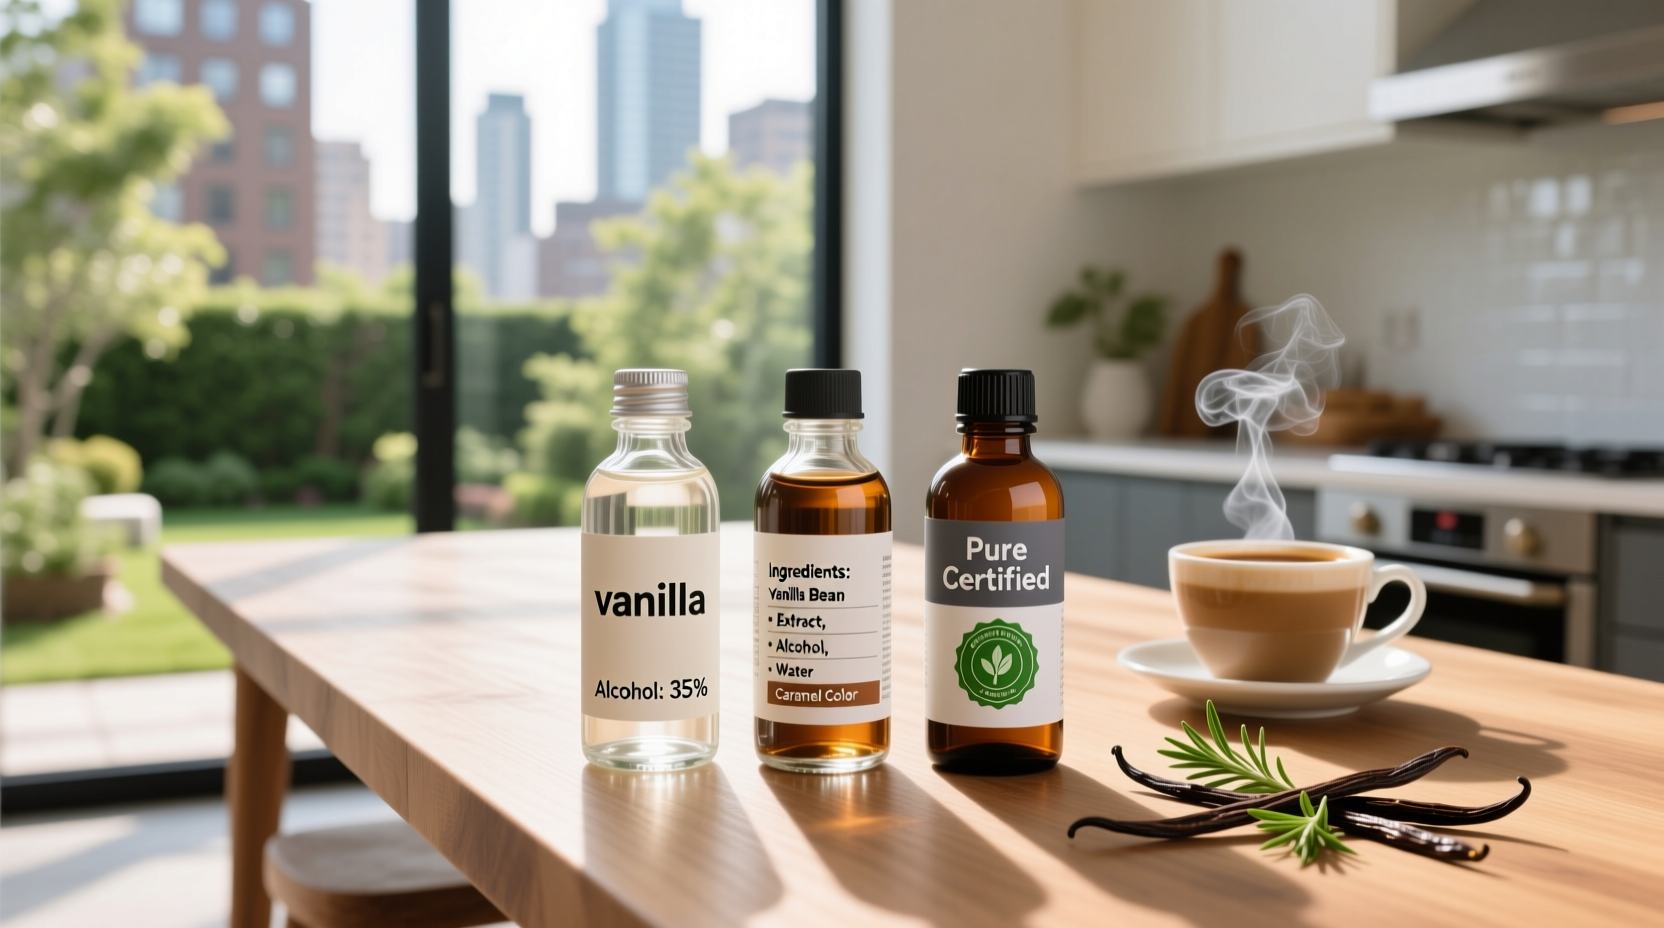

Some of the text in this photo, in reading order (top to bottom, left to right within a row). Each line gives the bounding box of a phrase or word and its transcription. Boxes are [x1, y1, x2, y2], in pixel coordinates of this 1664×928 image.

[966, 536, 1028, 561] Pure
[768, 562, 851, 582] Ingredients:
[942, 565, 1050, 591] Certified
[594, 582, 706, 617] vanilla
[808, 587, 845, 602] Bean
[776, 612, 826, 630] Extract,
[776, 638, 829, 656] Alcohol,
[776, 662, 814, 678] Water
[594, 677, 708, 700] Alcohol: 35%
[824, 687, 859, 702] Color
